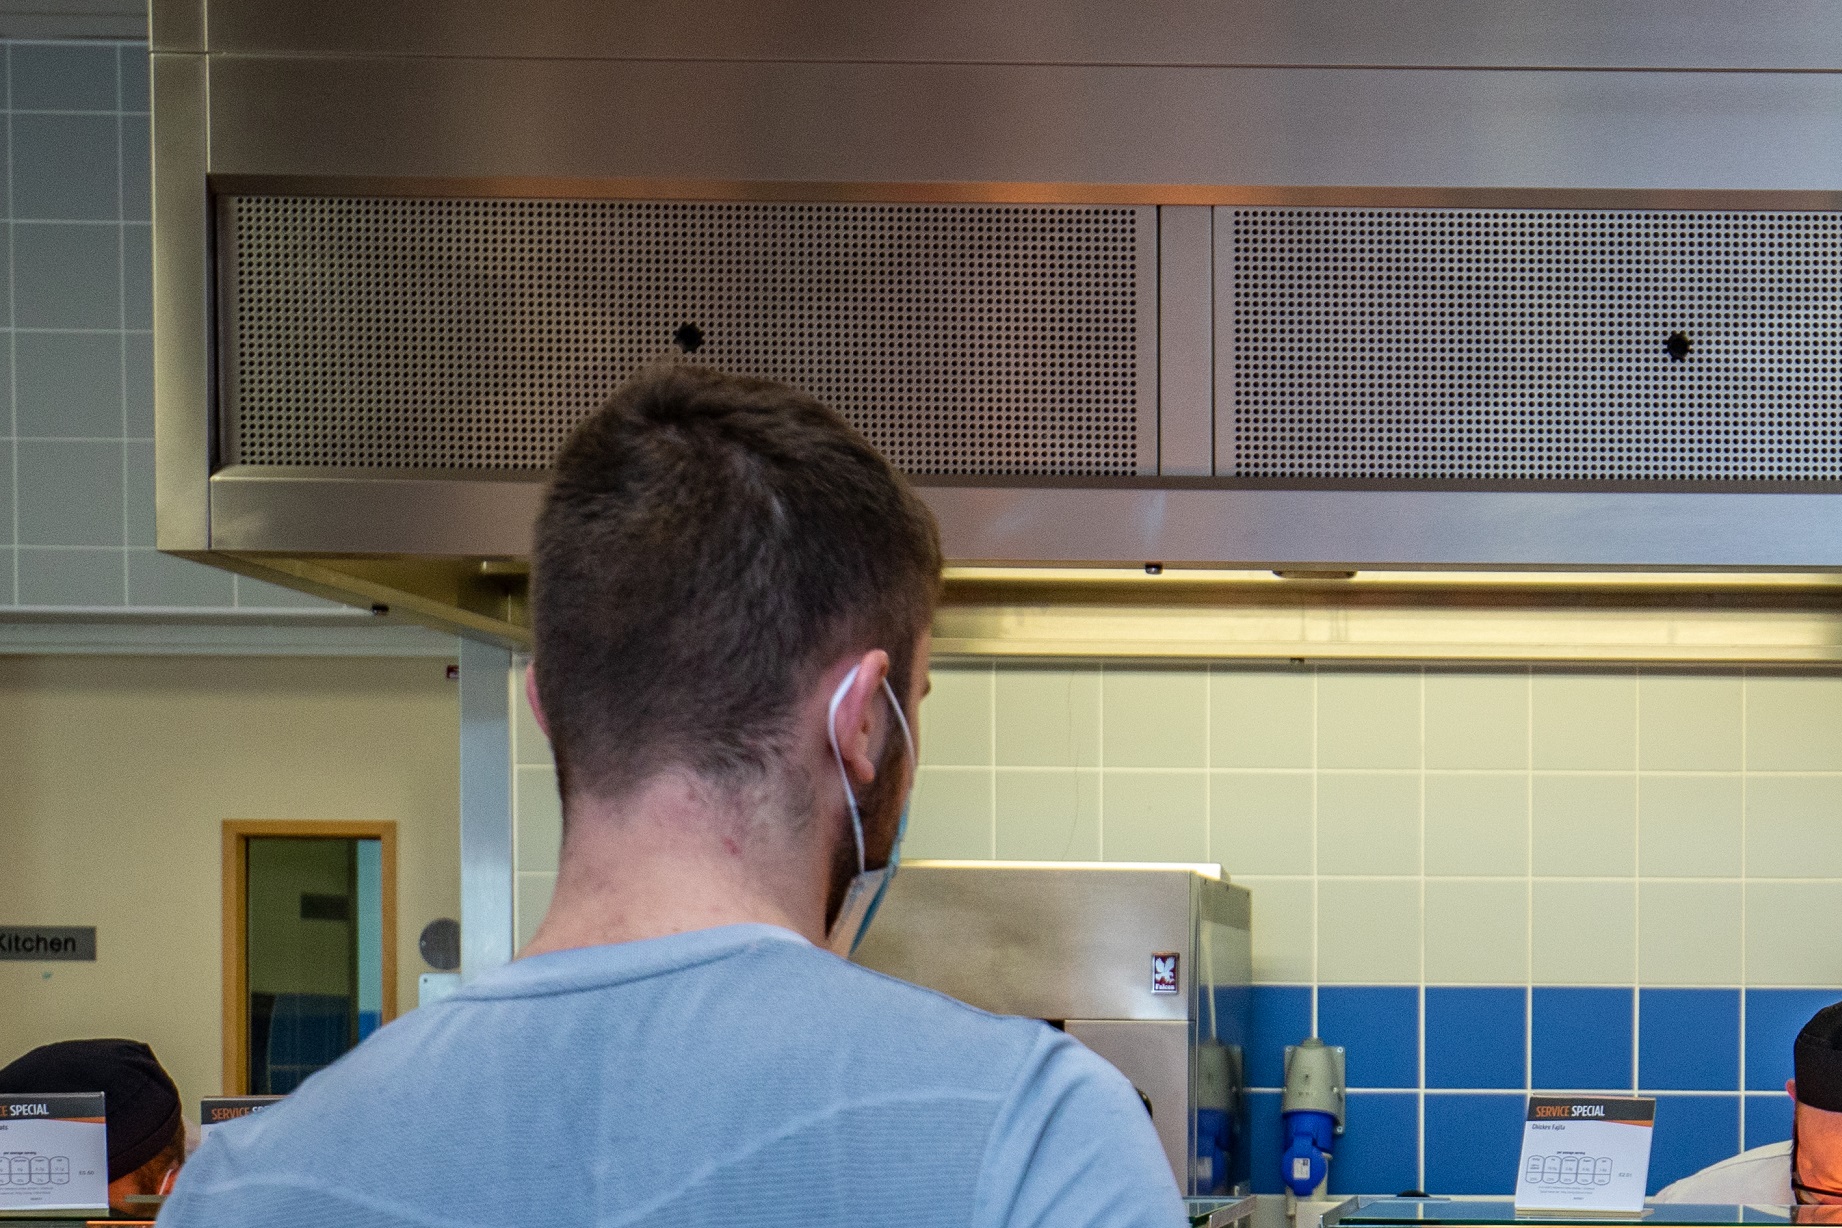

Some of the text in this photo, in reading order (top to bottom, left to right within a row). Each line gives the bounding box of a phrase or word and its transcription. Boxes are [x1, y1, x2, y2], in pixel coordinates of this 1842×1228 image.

[10, 1104, 49, 1116] SPECIAL
[211, 1107, 250, 1120] SERVICE
[1536, 1105, 1605, 1117] SERVICE SPECIAL
